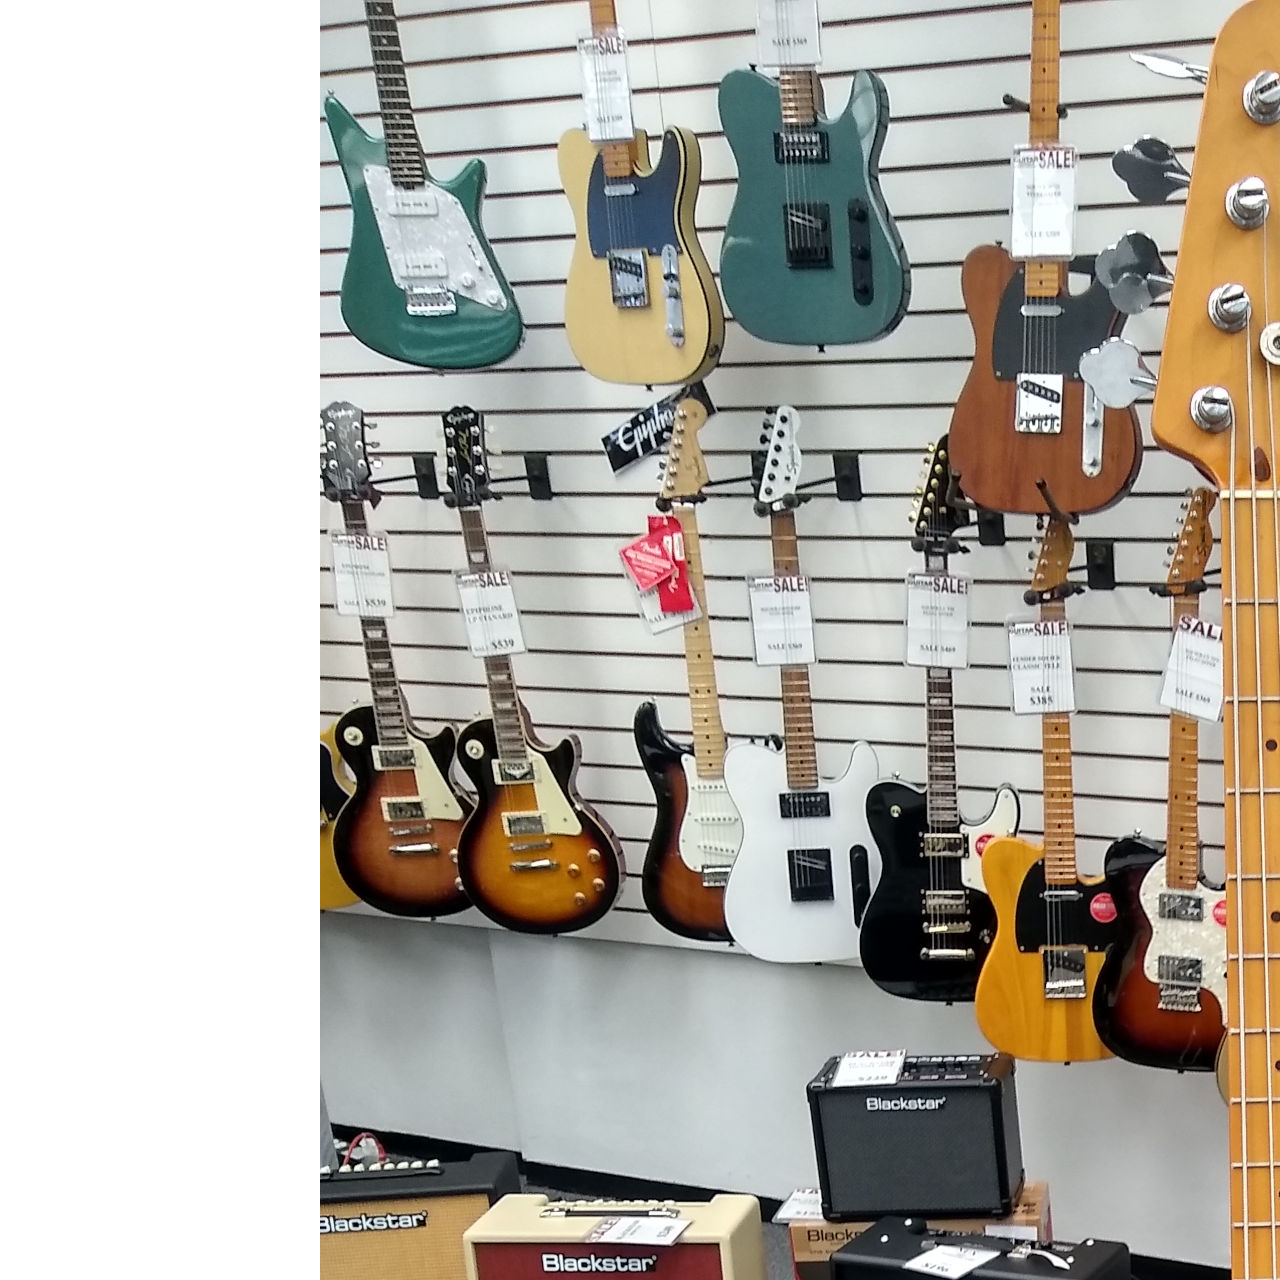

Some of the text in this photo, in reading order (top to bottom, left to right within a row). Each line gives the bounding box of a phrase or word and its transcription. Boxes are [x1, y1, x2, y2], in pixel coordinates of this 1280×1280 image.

[1039, 151, 1075, 169] SALE!
[616, 403, 675, 457] Epipho
[355, 535, 388, 551] SALE!
[774, 576, 808, 592] SALE!
[933, 578, 968, 594] SALE!
[1035, 622, 1069, 636] SALE!
[866, 1097, 945, 1111] Blackstar
[320, 1213, 424, 1233] Blackstar
[542, 1254, 654, 1272] Blackstar
